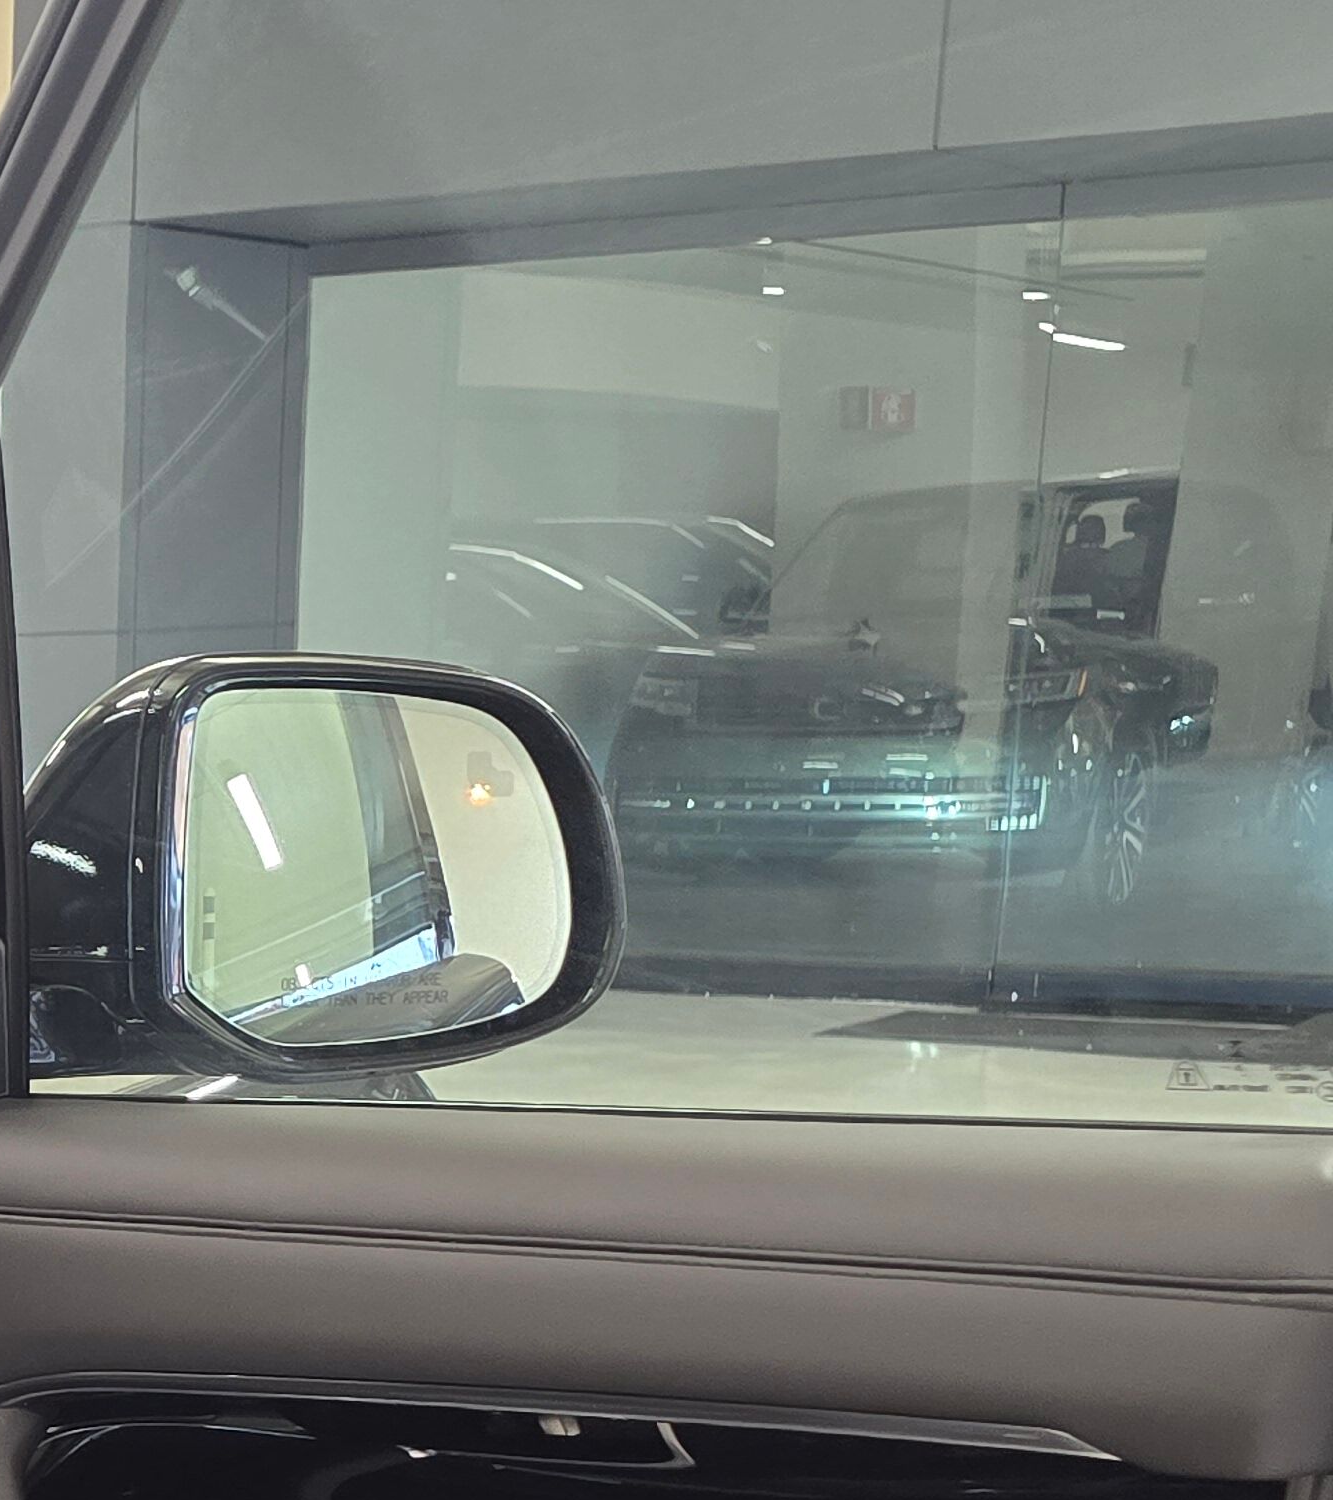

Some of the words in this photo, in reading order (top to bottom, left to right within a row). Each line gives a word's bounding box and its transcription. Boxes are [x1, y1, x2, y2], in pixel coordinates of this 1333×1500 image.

[419, 972, 442, 986] ARE
[365, 991, 396, 1006] THEY
[403, 989, 449, 1005] APPEAR
